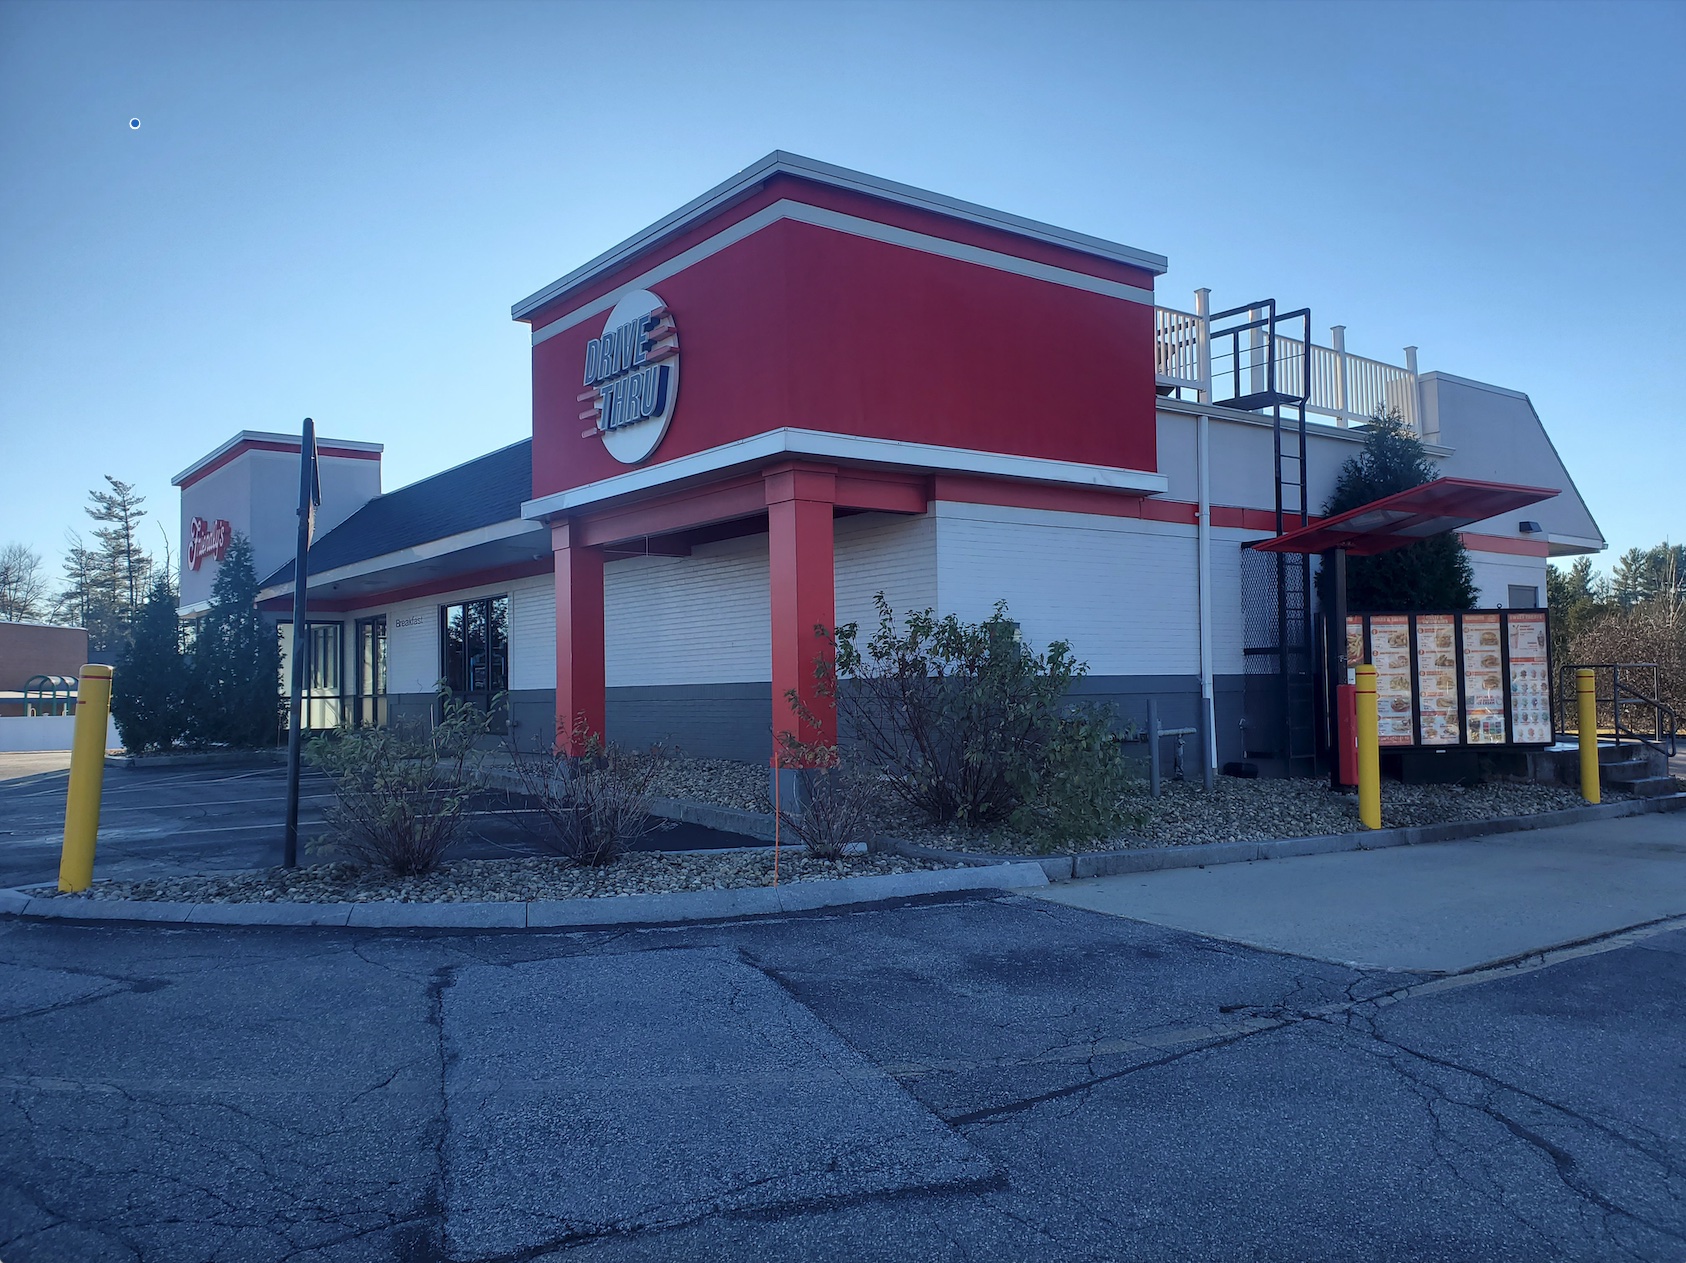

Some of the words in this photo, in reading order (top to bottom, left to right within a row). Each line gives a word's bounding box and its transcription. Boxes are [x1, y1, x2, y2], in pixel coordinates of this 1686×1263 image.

[583, 312, 654, 387] DRIVE
[599, 364, 668, 431] THRU
[395, 615, 424, 628] Breakfast
